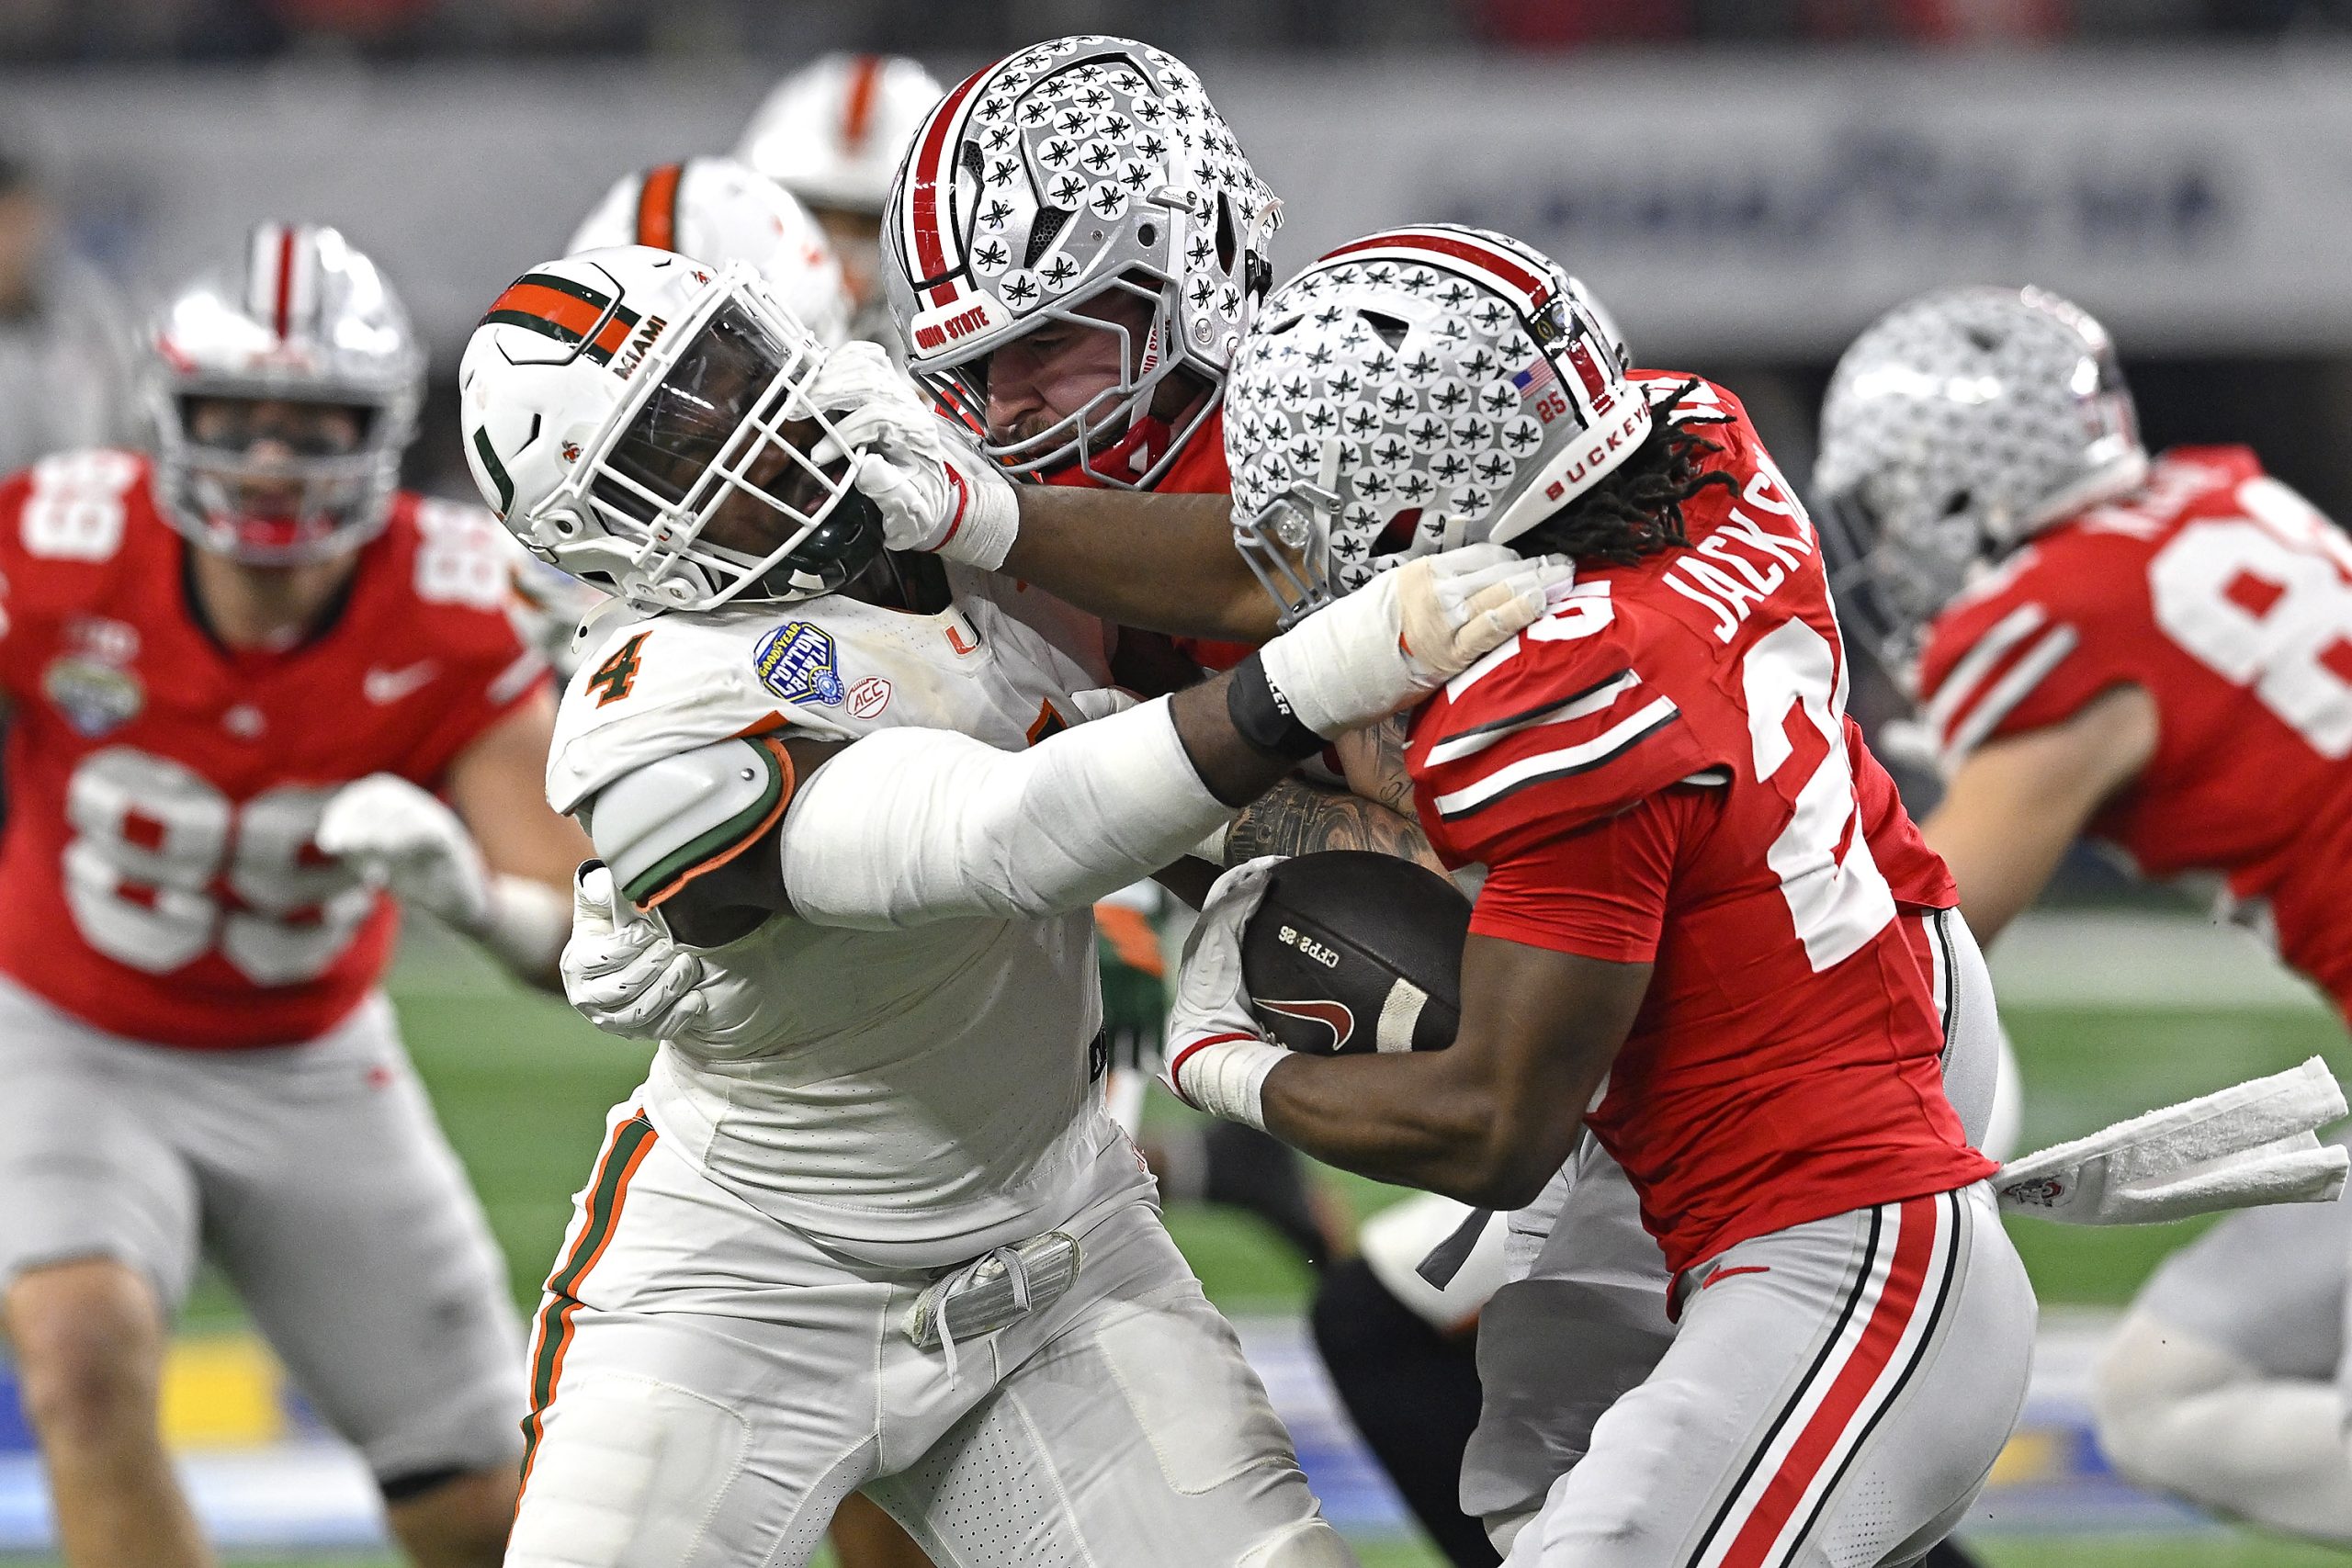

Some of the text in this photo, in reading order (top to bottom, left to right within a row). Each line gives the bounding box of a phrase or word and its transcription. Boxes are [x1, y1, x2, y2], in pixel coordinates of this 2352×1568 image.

[613, 314, 668, 381] MIAMI
[915, 305, 990, 350] OHIO STATE
[1536, 390, 1567, 423] 25
[584, 629, 654, 710] 4
[758, 622, 802, 678] GOODYEAR
[768, 627, 828, 696] COTTON
[789, 647, 827, 691] BOWL
[854, 679, 884, 712] ACC
